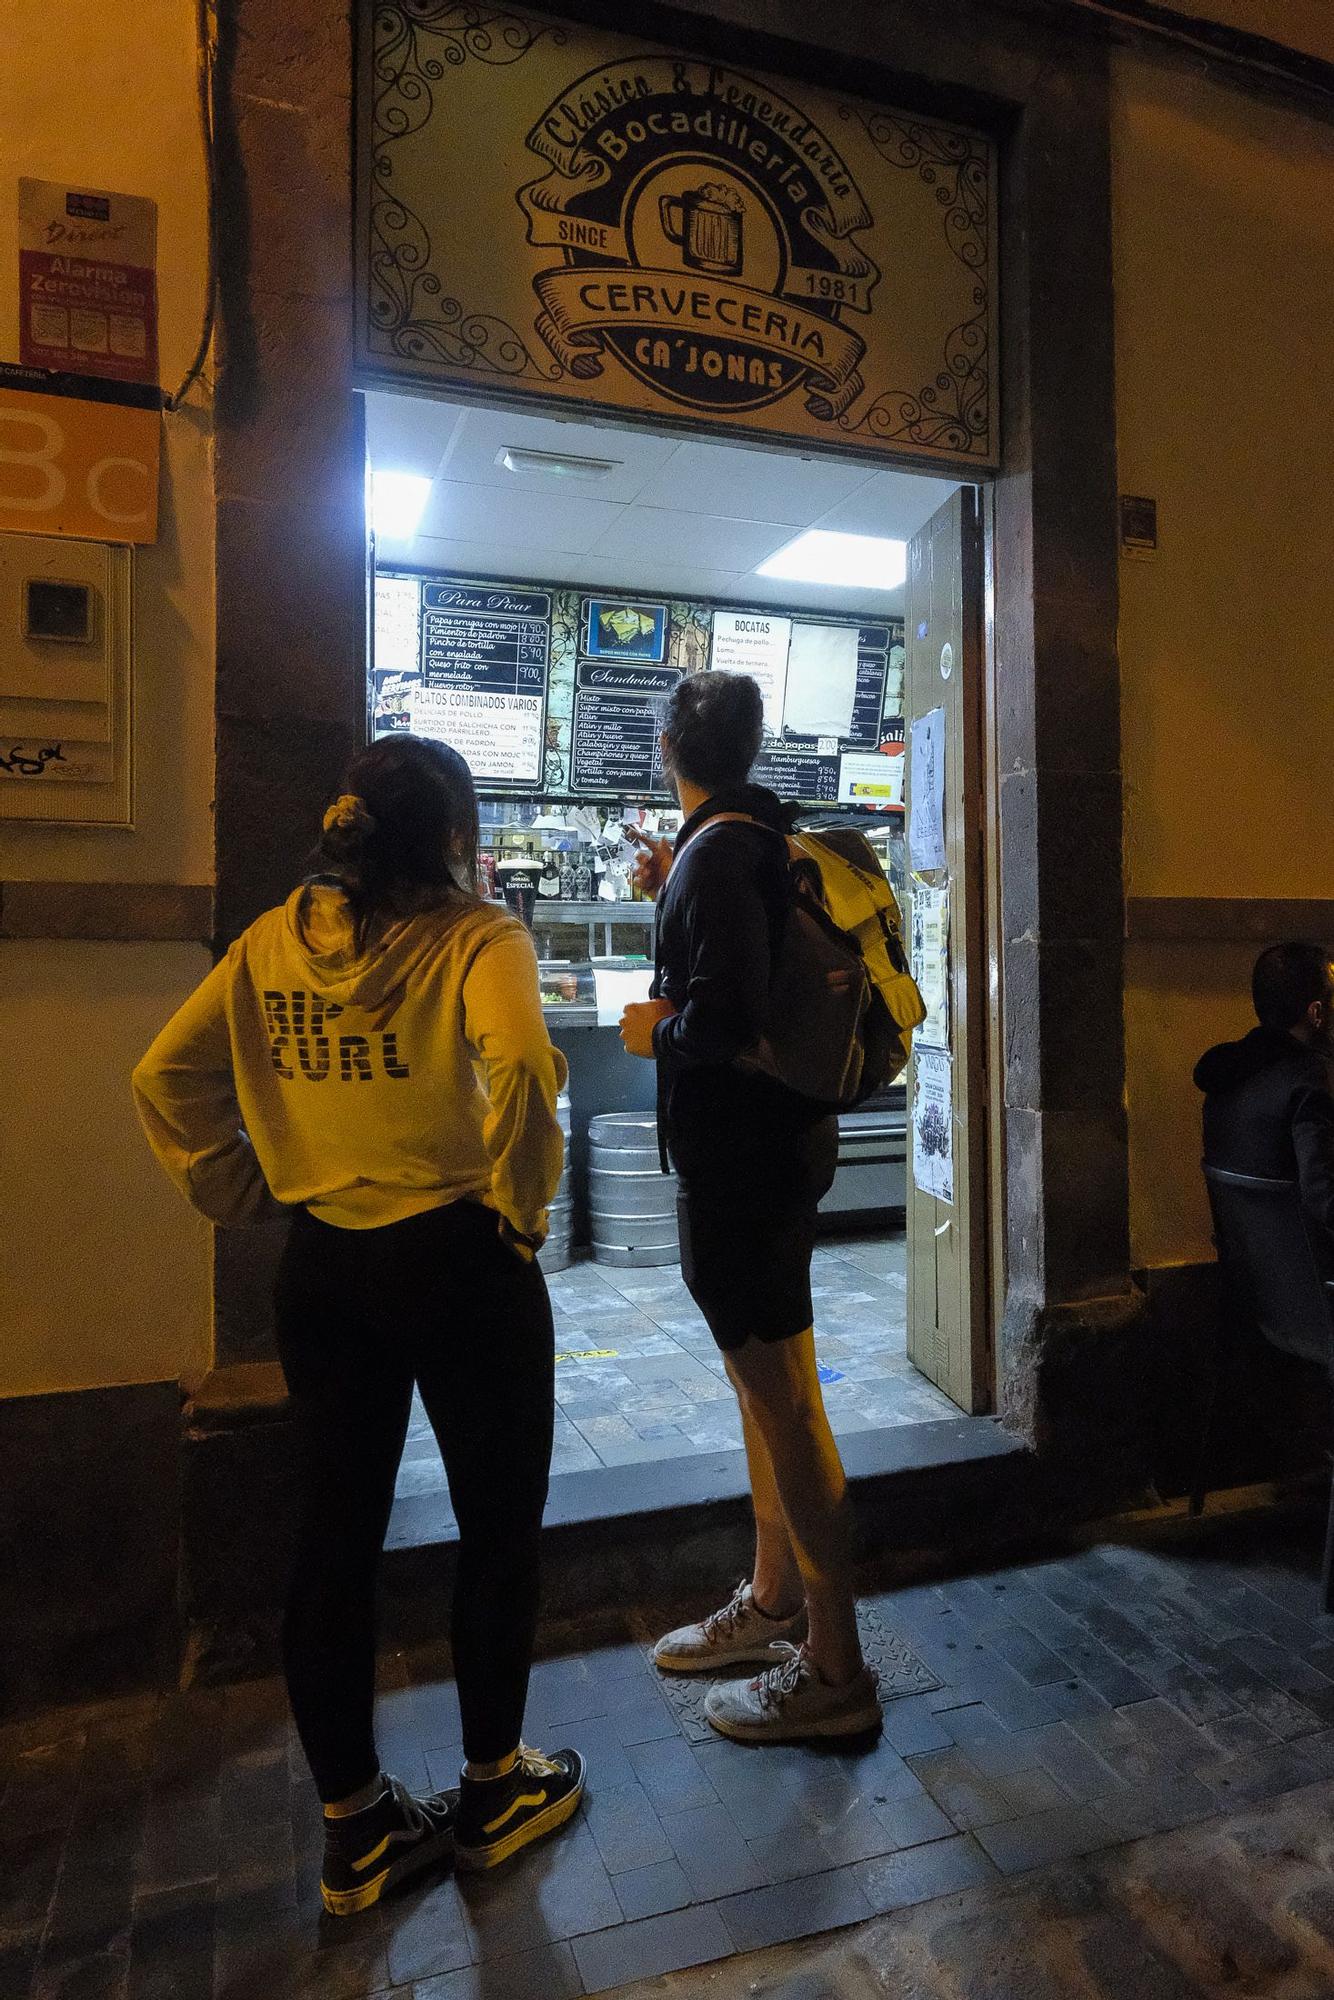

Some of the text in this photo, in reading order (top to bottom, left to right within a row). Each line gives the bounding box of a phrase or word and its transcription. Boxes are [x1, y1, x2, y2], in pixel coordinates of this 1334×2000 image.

[672, 63, 693, 95] &
[558, 220, 608, 248] SINCE
[51, 258, 127, 284] Alarma
[806, 274, 859, 303] 1981
[579, 284, 826, 358] CERVECERIA
[438, 589, 532, 612] Para Picar
[430, 616, 453, 627] Papas
[500, 623, 518, 633] mojo
[735, 620, 770, 633] BOCATAS
[430, 626, 467, 637] Pimientos
[468, 629, 478, 638] de
[430, 637, 496, 650] Pincho de tortilla
[717, 635, 744, 645] Pechuga
[753, 639, 769, 647] pollo
[429, 649, 445, 657] con
[446, 650, 483, 660] ensalada
[429, 659, 452, 669] Queso
[454, 660, 471, 670] frito
[716, 657, 736, 665] Vuelta
[429, 670, 473, 680] mermelada
[590, 669, 668, 687] Sandwiches
[428, 681, 474, 691] Huevos rotos
[414, 691, 538, 712] PLATOS COMBINADOS VARIOS
[580, 694, 600, 702] Mixto
[579, 703, 599, 713] Super
[635, 708, 656, 717] papas
[414, 719, 445, 727] SURTIDO
[459, 720, 498, 730] SALCHICHA
[603, 723, 623, 731] millo
[414, 726, 490, 736] CHORIZO PARRILLERO
[602, 731, 624, 740] huevo
[621, 744, 640, 752] queso
[770, 739, 785, 748] de
[785, 741, 815, 750] papas
[483, 750, 499, 758] CON
[630, 753, 650, 761] queso
[577, 759, 604, 768] Vegetal
[771, 755, 821, 766] Hamburguesas
[577, 767, 604, 775] Tortilla
[774, 766, 797, 774] especial
[581, 776, 609, 785] tomates
[777, 782, 801, 790] especial
[264, 990, 345, 1036] RIP
[271, 1032, 410, 1082] CURL
